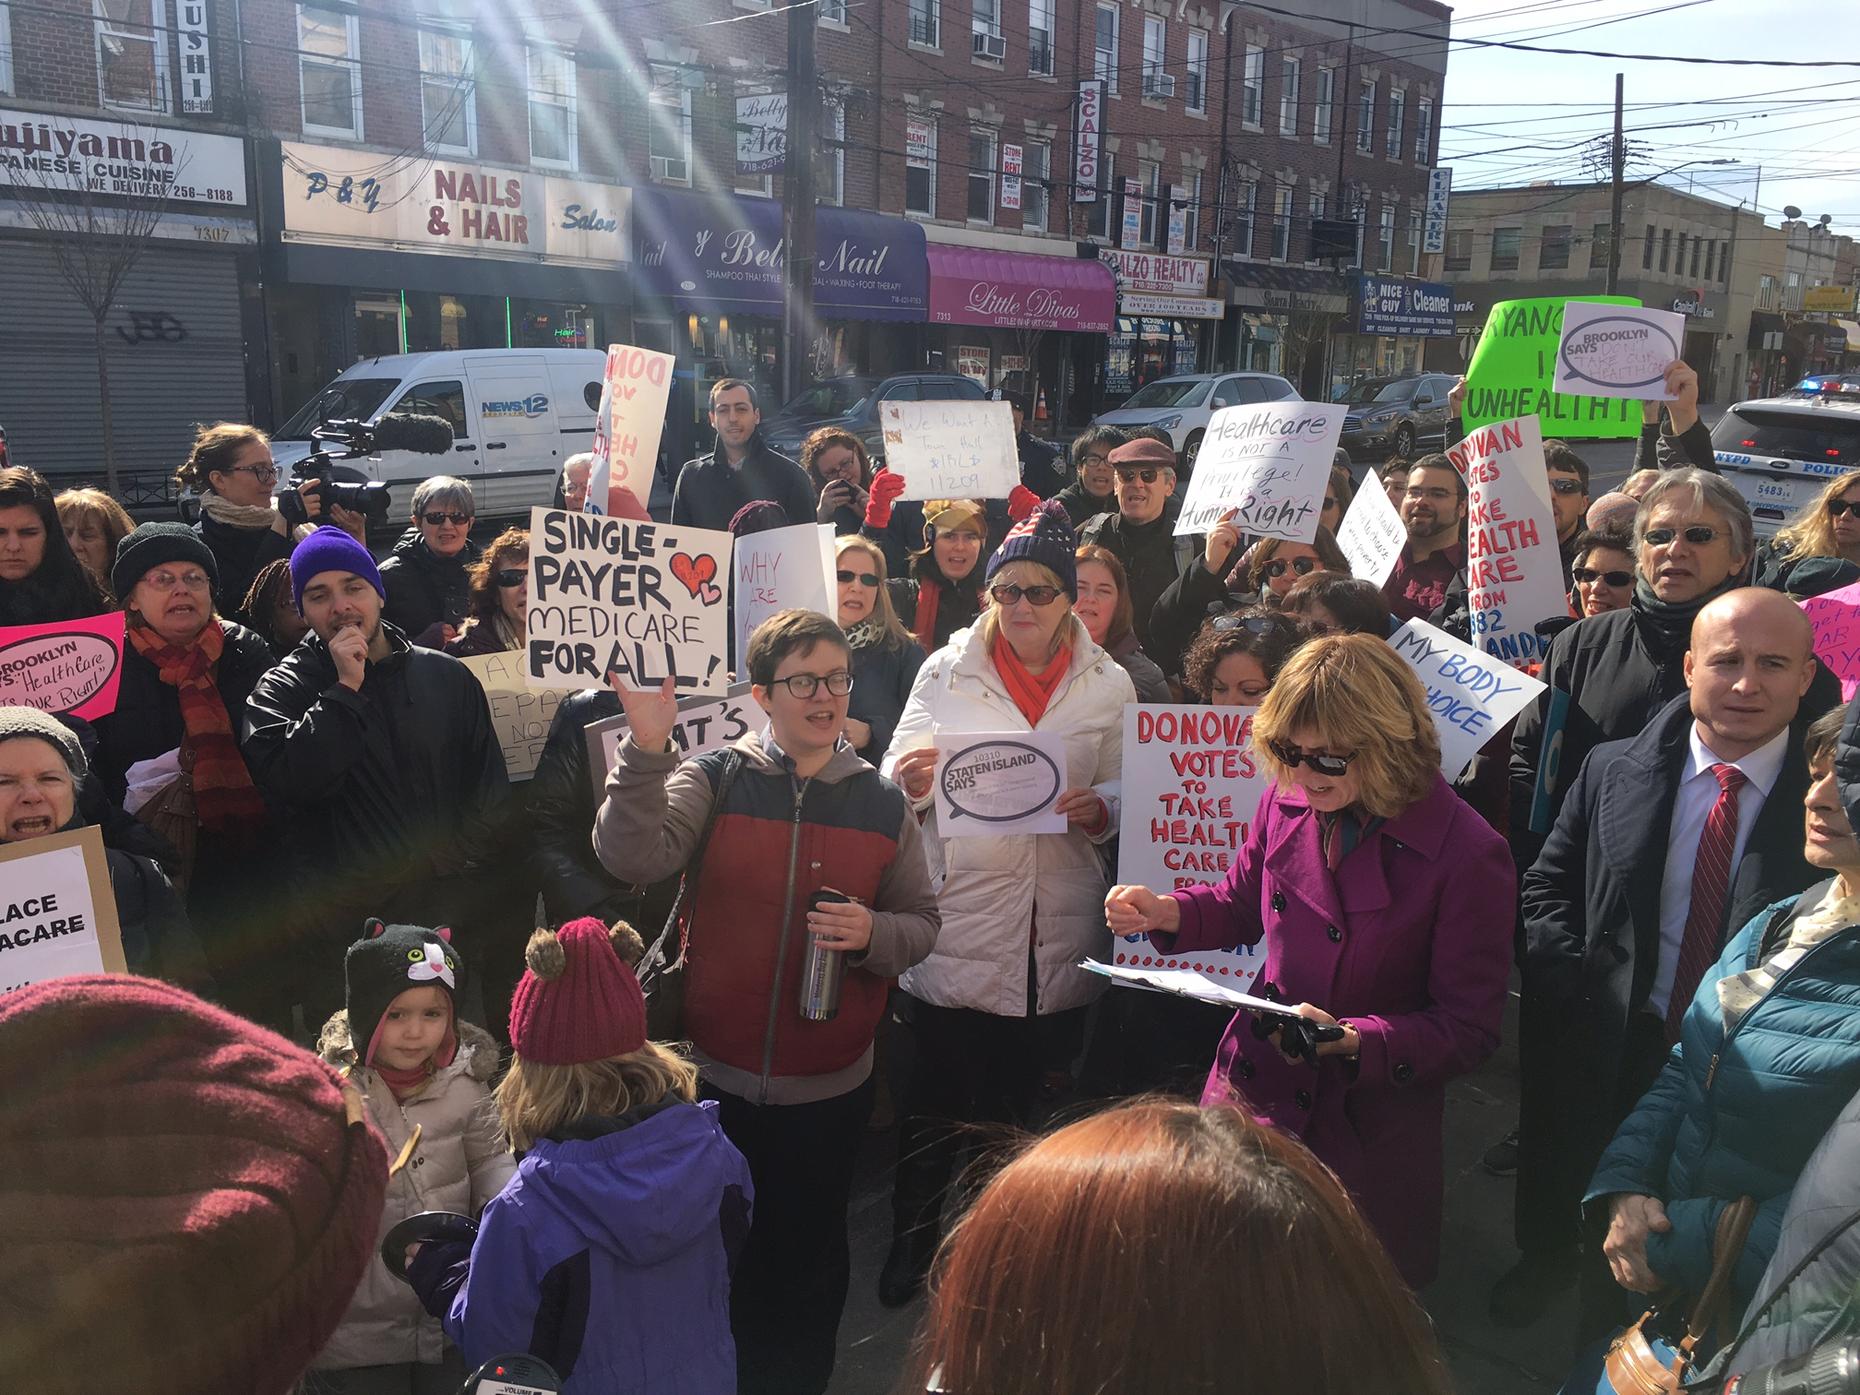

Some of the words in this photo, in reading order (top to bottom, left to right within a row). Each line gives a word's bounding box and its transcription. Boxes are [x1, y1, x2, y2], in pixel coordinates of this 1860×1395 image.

[184, 0, 206, 98] USHI
[1078, 88, 1095, 177] SCALZO
[94, 163, 175, 183] CUISINE
[435, 169, 522, 210] NAILS
[427, 205, 451, 237] &
[462, 208, 530, 245] HAIR
[561, 203, 618, 233] Salon
[818, 240, 889, 276] Nail
[1154, 257, 1197, 283] REALTY
[964, 281, 1020, 315] Little
[1026, 288, 1080, 319] Divas
[1380, 284, 1402, 298] NICE
[1381, 299, 1400, 313] GUY
[1413, 289, 1450, 313] Cleaner
[1566, 343, 1597, 355] SAYS
[1583, 329, 1648, 344] BROOKLYN
[1206, 410, 1327, 444] Healthcare
[1239, 442, 1271, 456] NOT
[1279, 441, 1290, 452] A
[1715, 452, 1751, 465] NYPD
[1802, 462, 1849, 476] POLIC
[929, 474, 980, 491] 11209
[1757, 483, 1783, 497] 5483
[1233, 495, 1313, 529] Right
[1470, 498, 1507, 528] AKE
[1470, 517, 1541, 559] EALTH
[534, 555, 672, 611] PAYER
[738, 551, 782, 587] WHY
[1471, 555, 1525, 590] ARE
[528, 605, 704, 644] MEDICARE
[0, 640, 78, 678] ROOKLYN
[529, 639, 601, 679] FOR
[1394, 630, 1448, 665] MY
[1437, 653, 1522, 704] BODY
[1426, 685, 1493, 736] HOICE
[1137, 710, 1254, 746] DONOVA
[947, 761, 991, 781] STATEN
[992, 753, 1037, 771] ISLAND
[973, 750, 1001, 763] 10310
[1170, 749, 1256, 780] VOTES
[946, 776, 976, 793] SAYS
[1181, 779, 1207, 795] TO
[1158, 792, 1234, 820] TAKE
[1163, 848, 1230, 873] CARE
